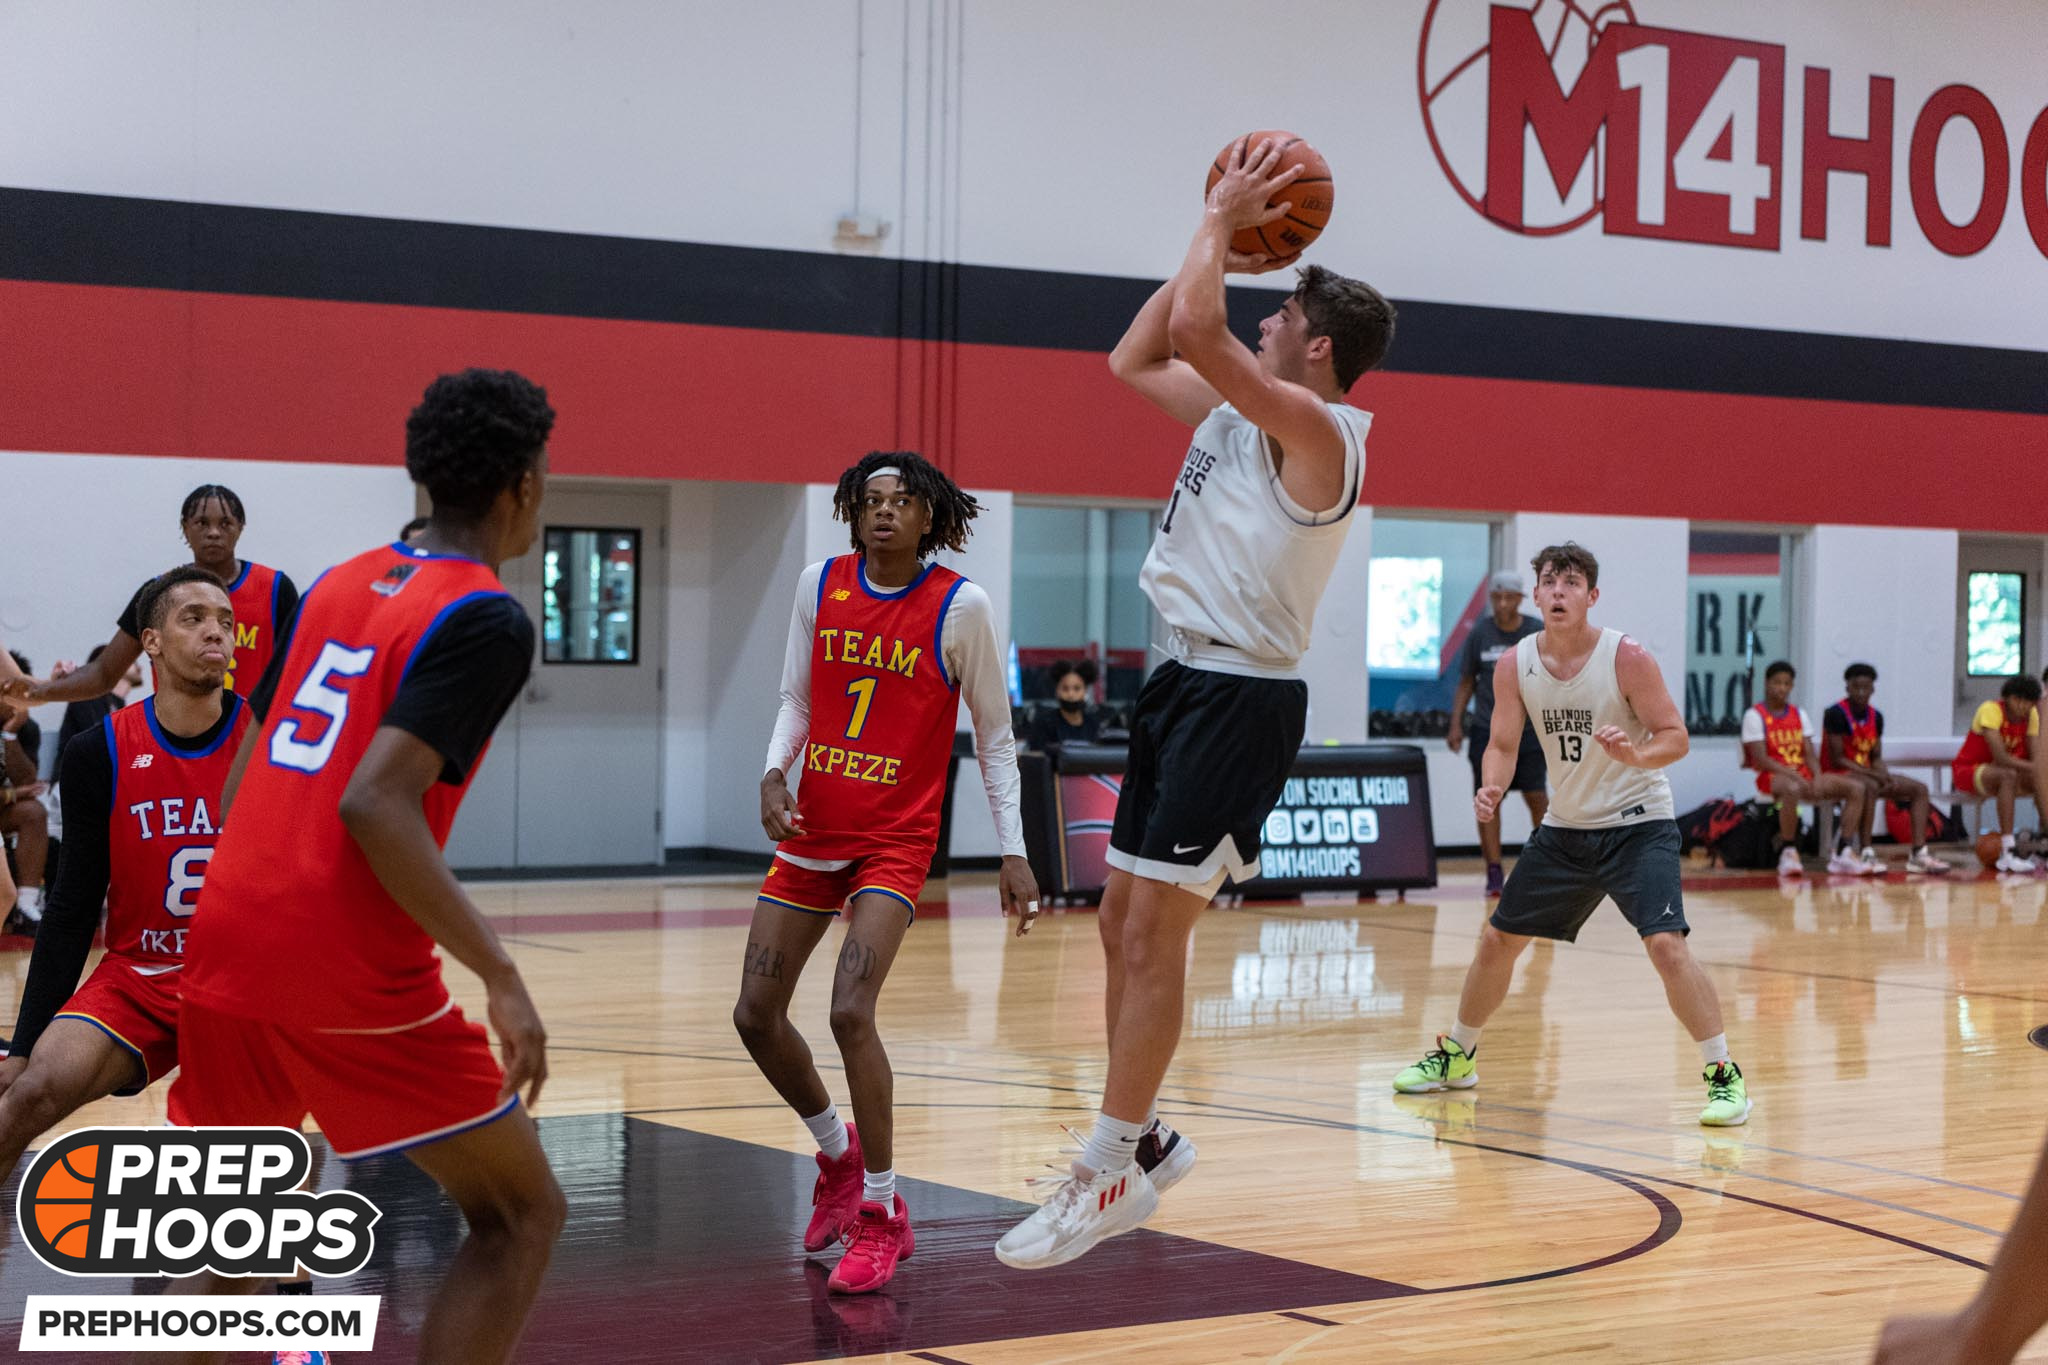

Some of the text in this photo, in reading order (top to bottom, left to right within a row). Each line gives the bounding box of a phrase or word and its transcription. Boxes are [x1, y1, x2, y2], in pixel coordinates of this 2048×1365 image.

[819, 629, 922, 678] TEAM
[269, 640, 377, 775] 5
[846, 676, 878, 740] 1
[1542, 709, 1592, 720] ILLINOIS
[1544, 720, 1593, 736] BEARS
[808, 743, 901, 786] KPEZE
[1558, 735, 1582, 762] 13
[1307, 777, 1361, 806] SOCIAL
[1361, 776, 1409, 805] MEDIA
[130, 798, 223, 840] TEA
[1261, 846, 1361, 878] @M14HOOPS
